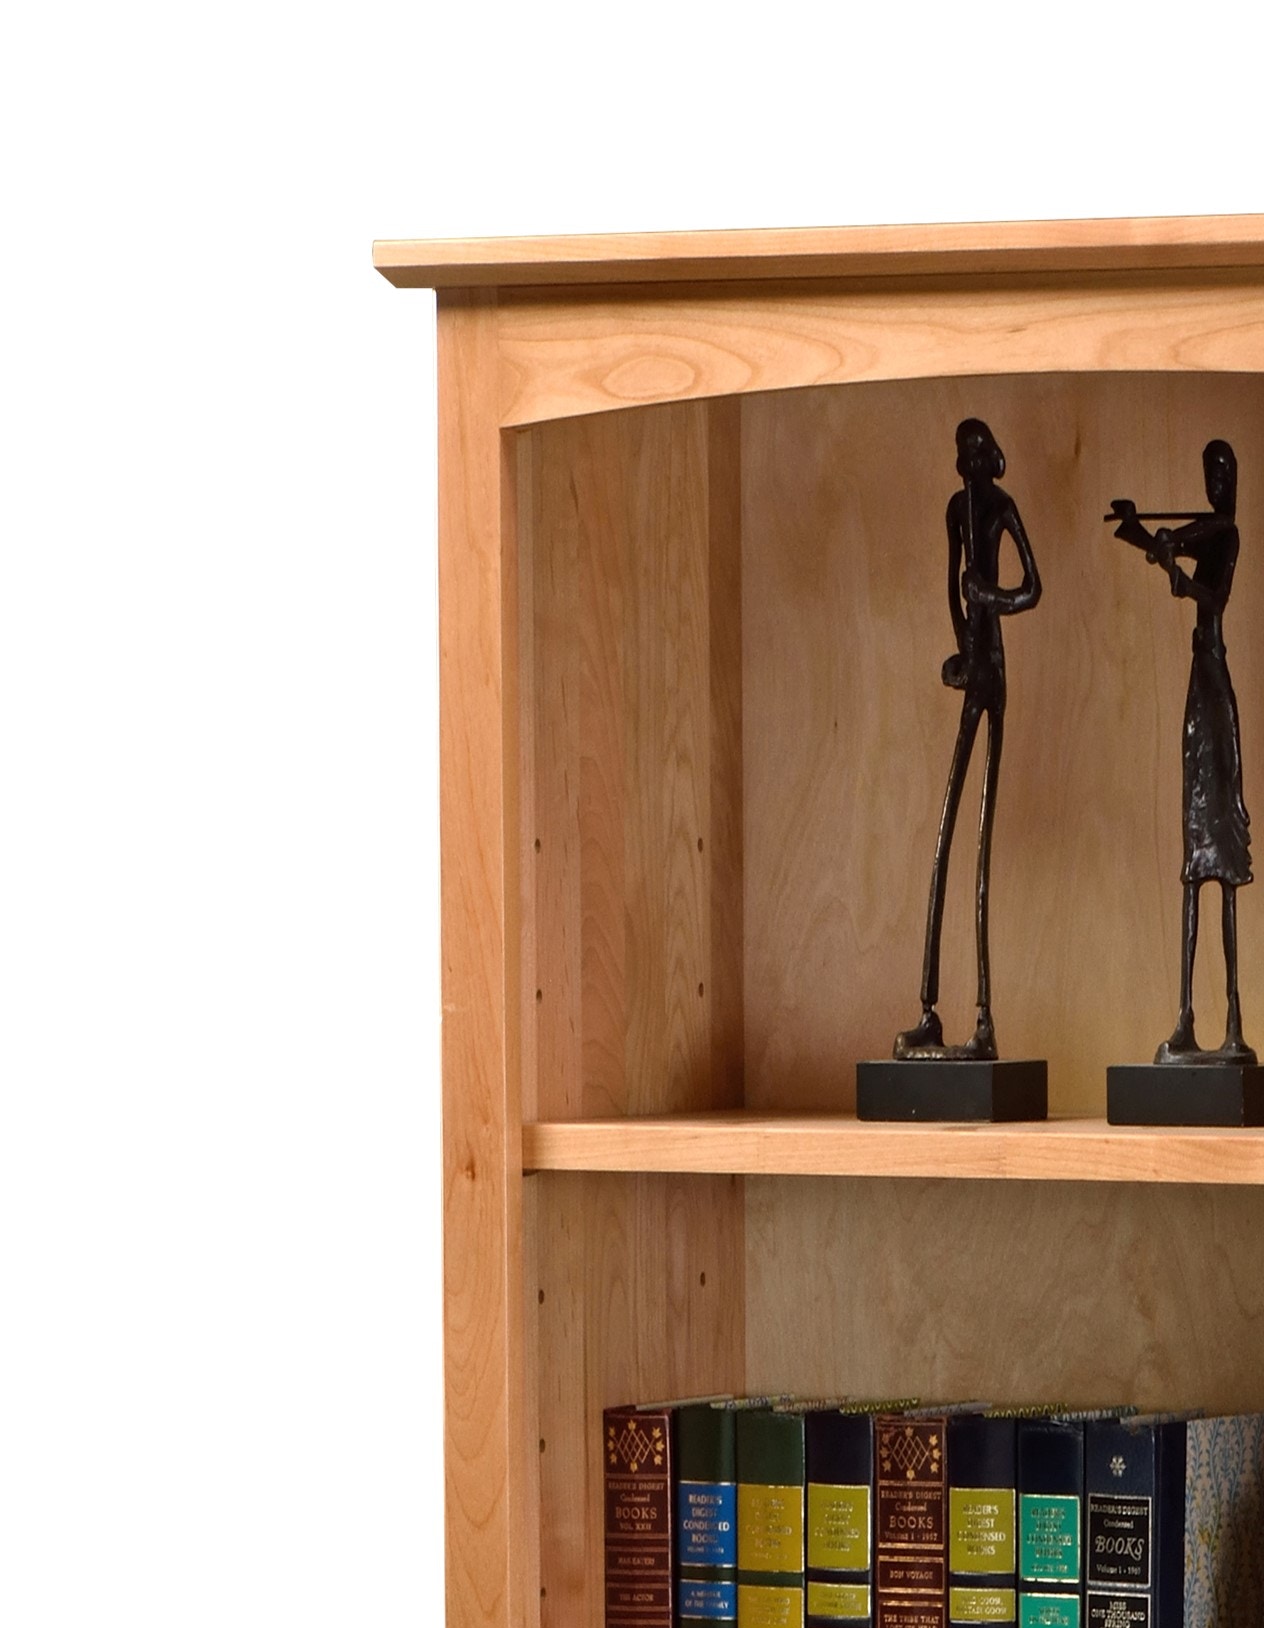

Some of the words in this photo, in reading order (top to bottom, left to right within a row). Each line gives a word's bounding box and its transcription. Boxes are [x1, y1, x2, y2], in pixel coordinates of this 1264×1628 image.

[638, 1482, 665, 1490] DIGEST
[915, 1491, 942, 1500] DIGEST
[615, 1507, 658, 1520] BOOKS
[1122, 1505, 1148, 1516] DIGEST
[889, 1516, 934, 1529] BOOKS
[1094, 1536, 1145, 1561] BOOKS
[905, 1570, 934, 1579] VOYAGE
[1109, 1601, 1127, 1610] MISS
[884, 1614, 897, 1622] THE
[920, 1615, 940, 1624] THAT
[1091, 1609, 1106, 1617] ONE
[1106, 1610, 1146, 1621] THOUSAND
